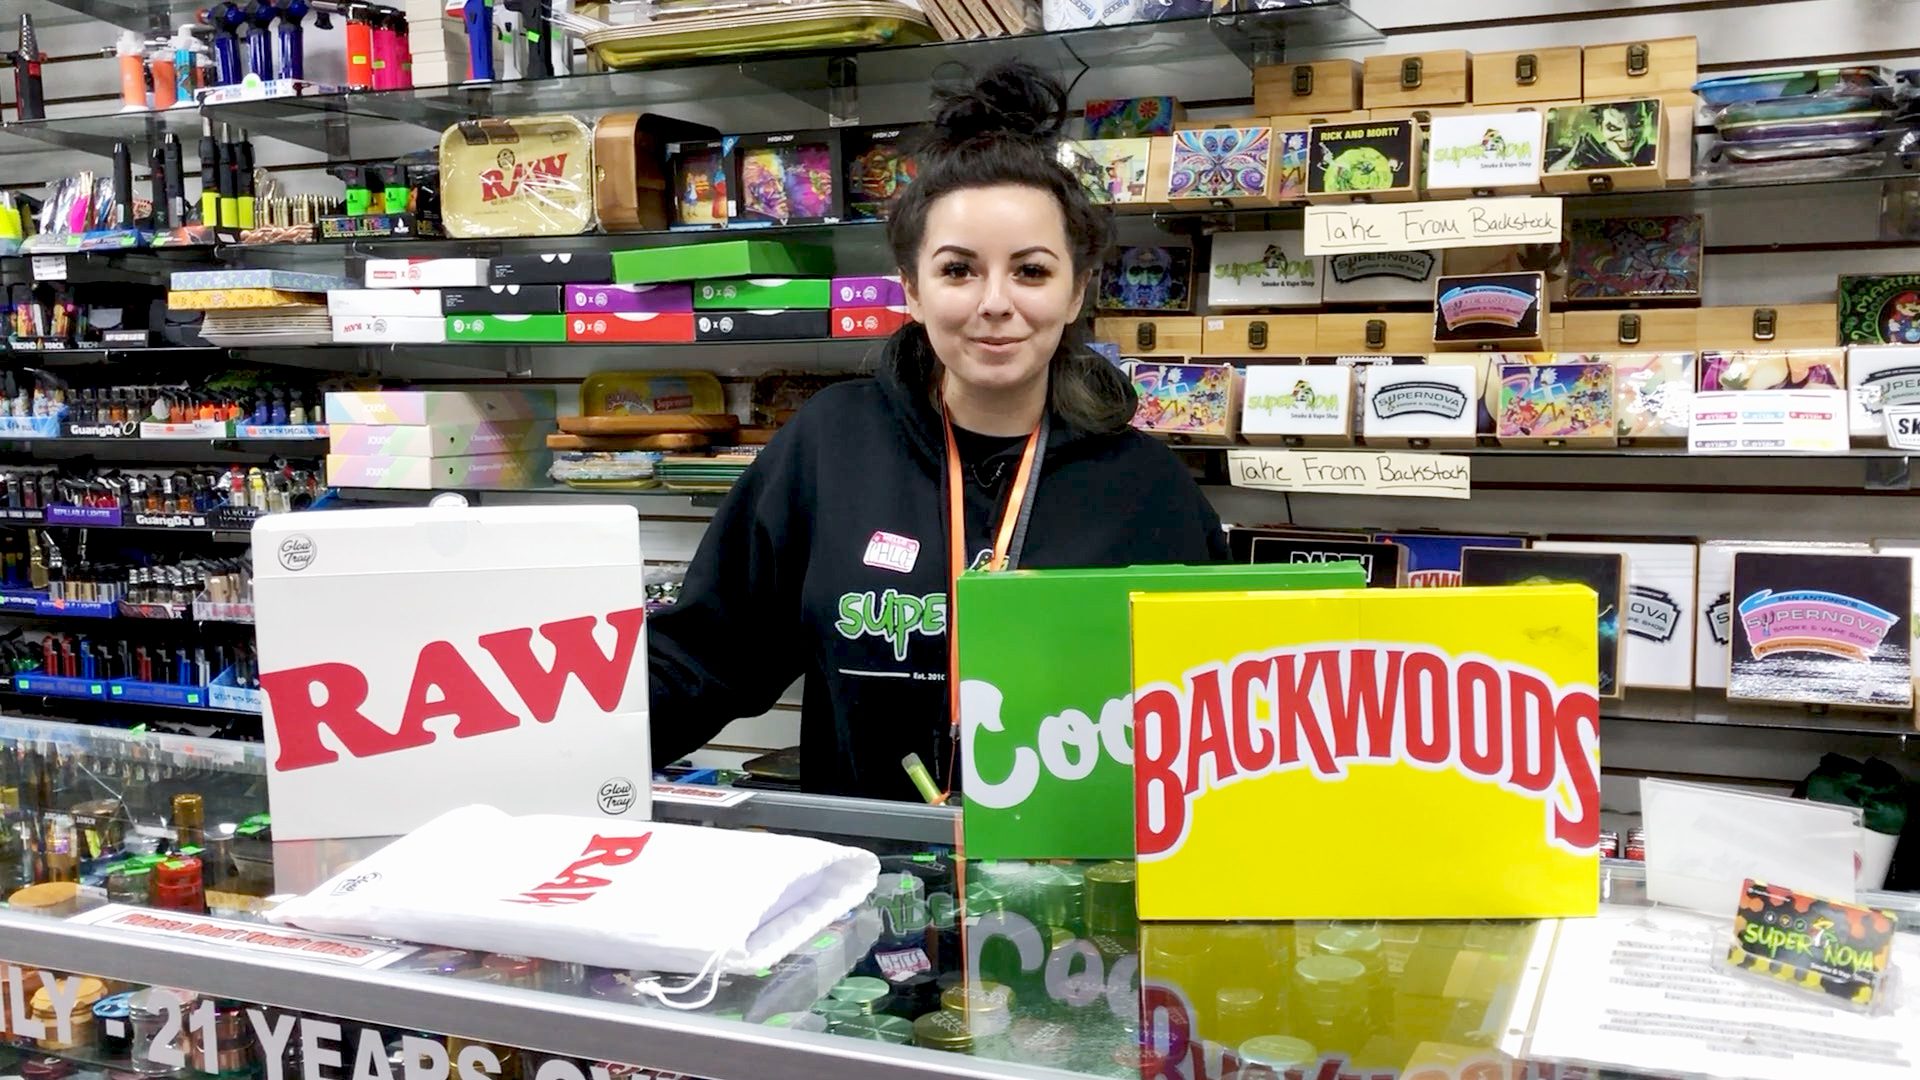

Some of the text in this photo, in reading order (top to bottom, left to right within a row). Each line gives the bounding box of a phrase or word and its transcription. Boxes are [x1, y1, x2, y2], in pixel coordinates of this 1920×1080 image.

[1320, 127, 1400, 142] RICK AND MORTY
[479, 153, 569, 203] RAW
[1308, 205, 1558, 241] Take From Backstock
[1378, 391, 1460, 408] SUPERNOVA
[1231, 455, 1469, 482] Take From Backstock
[281, 539, 313, 554] Glow
[283, 552, 313, 567] Tray
[1630, 602, 1668, 625] OVA
[1747, 608, 1883, 637] SUPERNOVA
[1773, 624, 1807, 634] SMOKE
[1820, 626, 1847, 635] VAPE
[259, 607, 644, 772] RAW
[1133, 647, 1600, 857] BACKWOODS
[600, 781, 632, 797] Glow
[603, 796, 632, 811] Tray
[1743, 921, 1875, 973] SUPER NOVA
[0, 964, 82, 1045] LY
[148, 985, 220, 1075] 21
